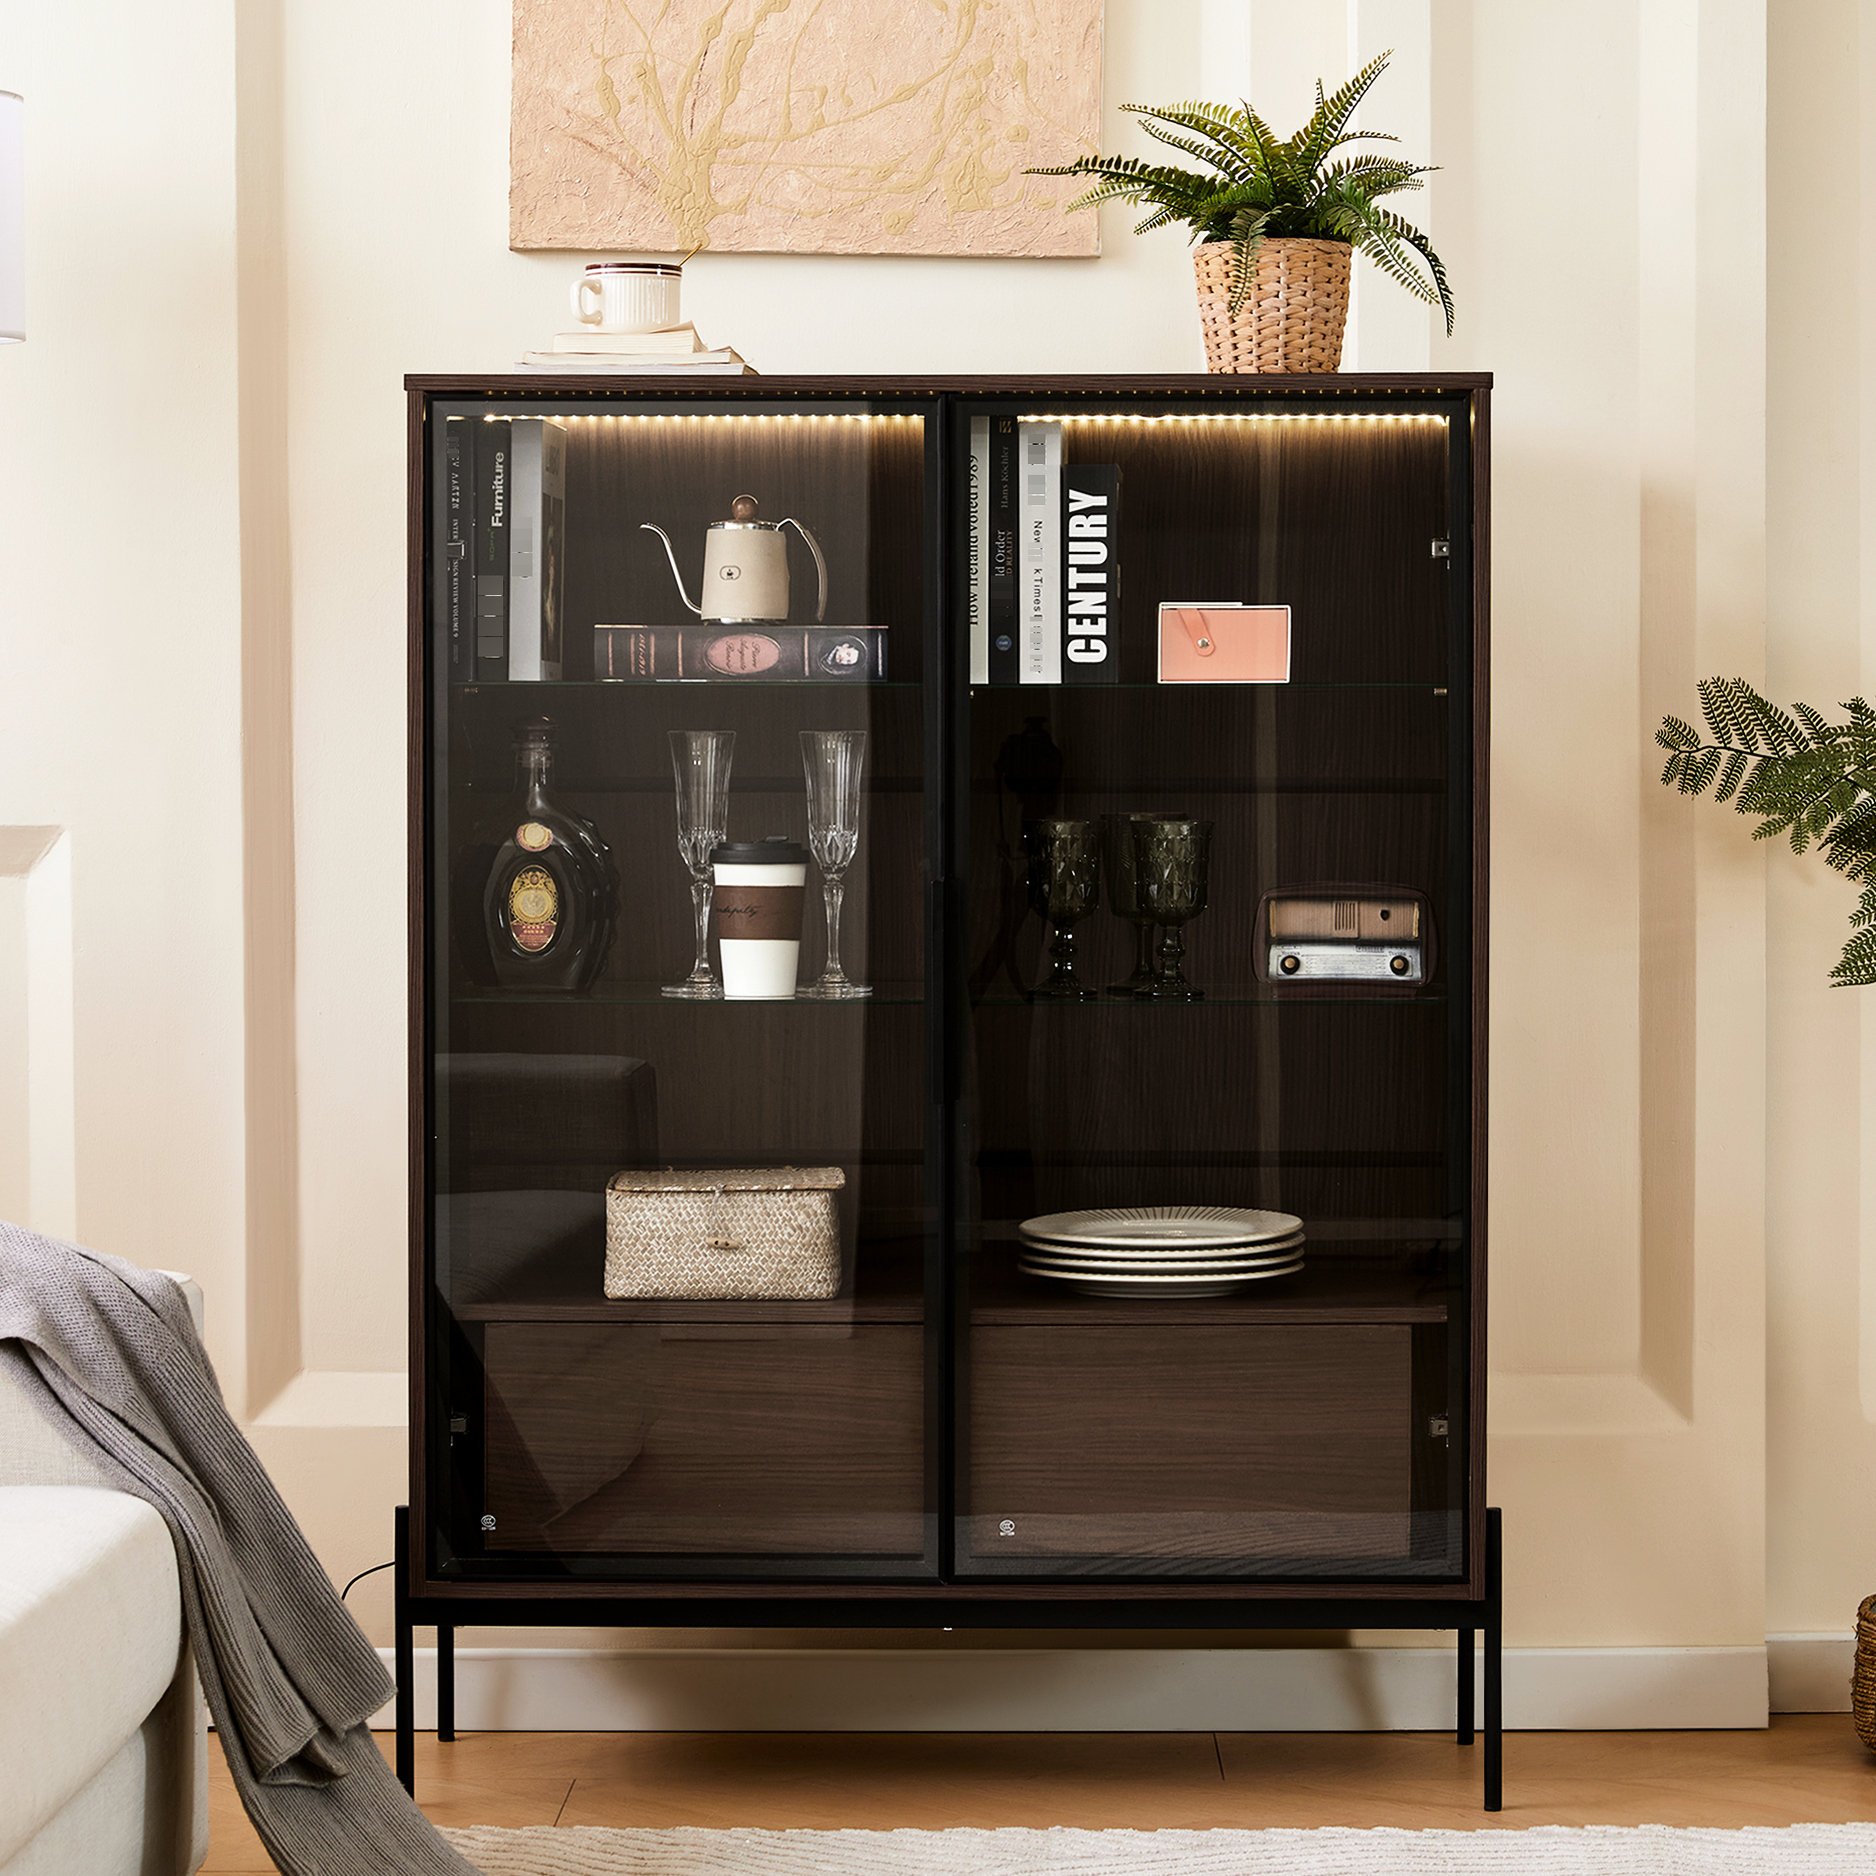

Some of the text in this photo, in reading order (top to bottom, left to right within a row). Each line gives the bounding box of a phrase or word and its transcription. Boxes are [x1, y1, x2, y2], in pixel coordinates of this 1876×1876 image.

[491, 452, 505, 527] Furniture
[1000, 484, 1009, 508] Hans
[994, 529, 1005, 563] Order
[1067, 489, 1108, 664] CENTURY
[1033, 577, 1043, 612] Times
